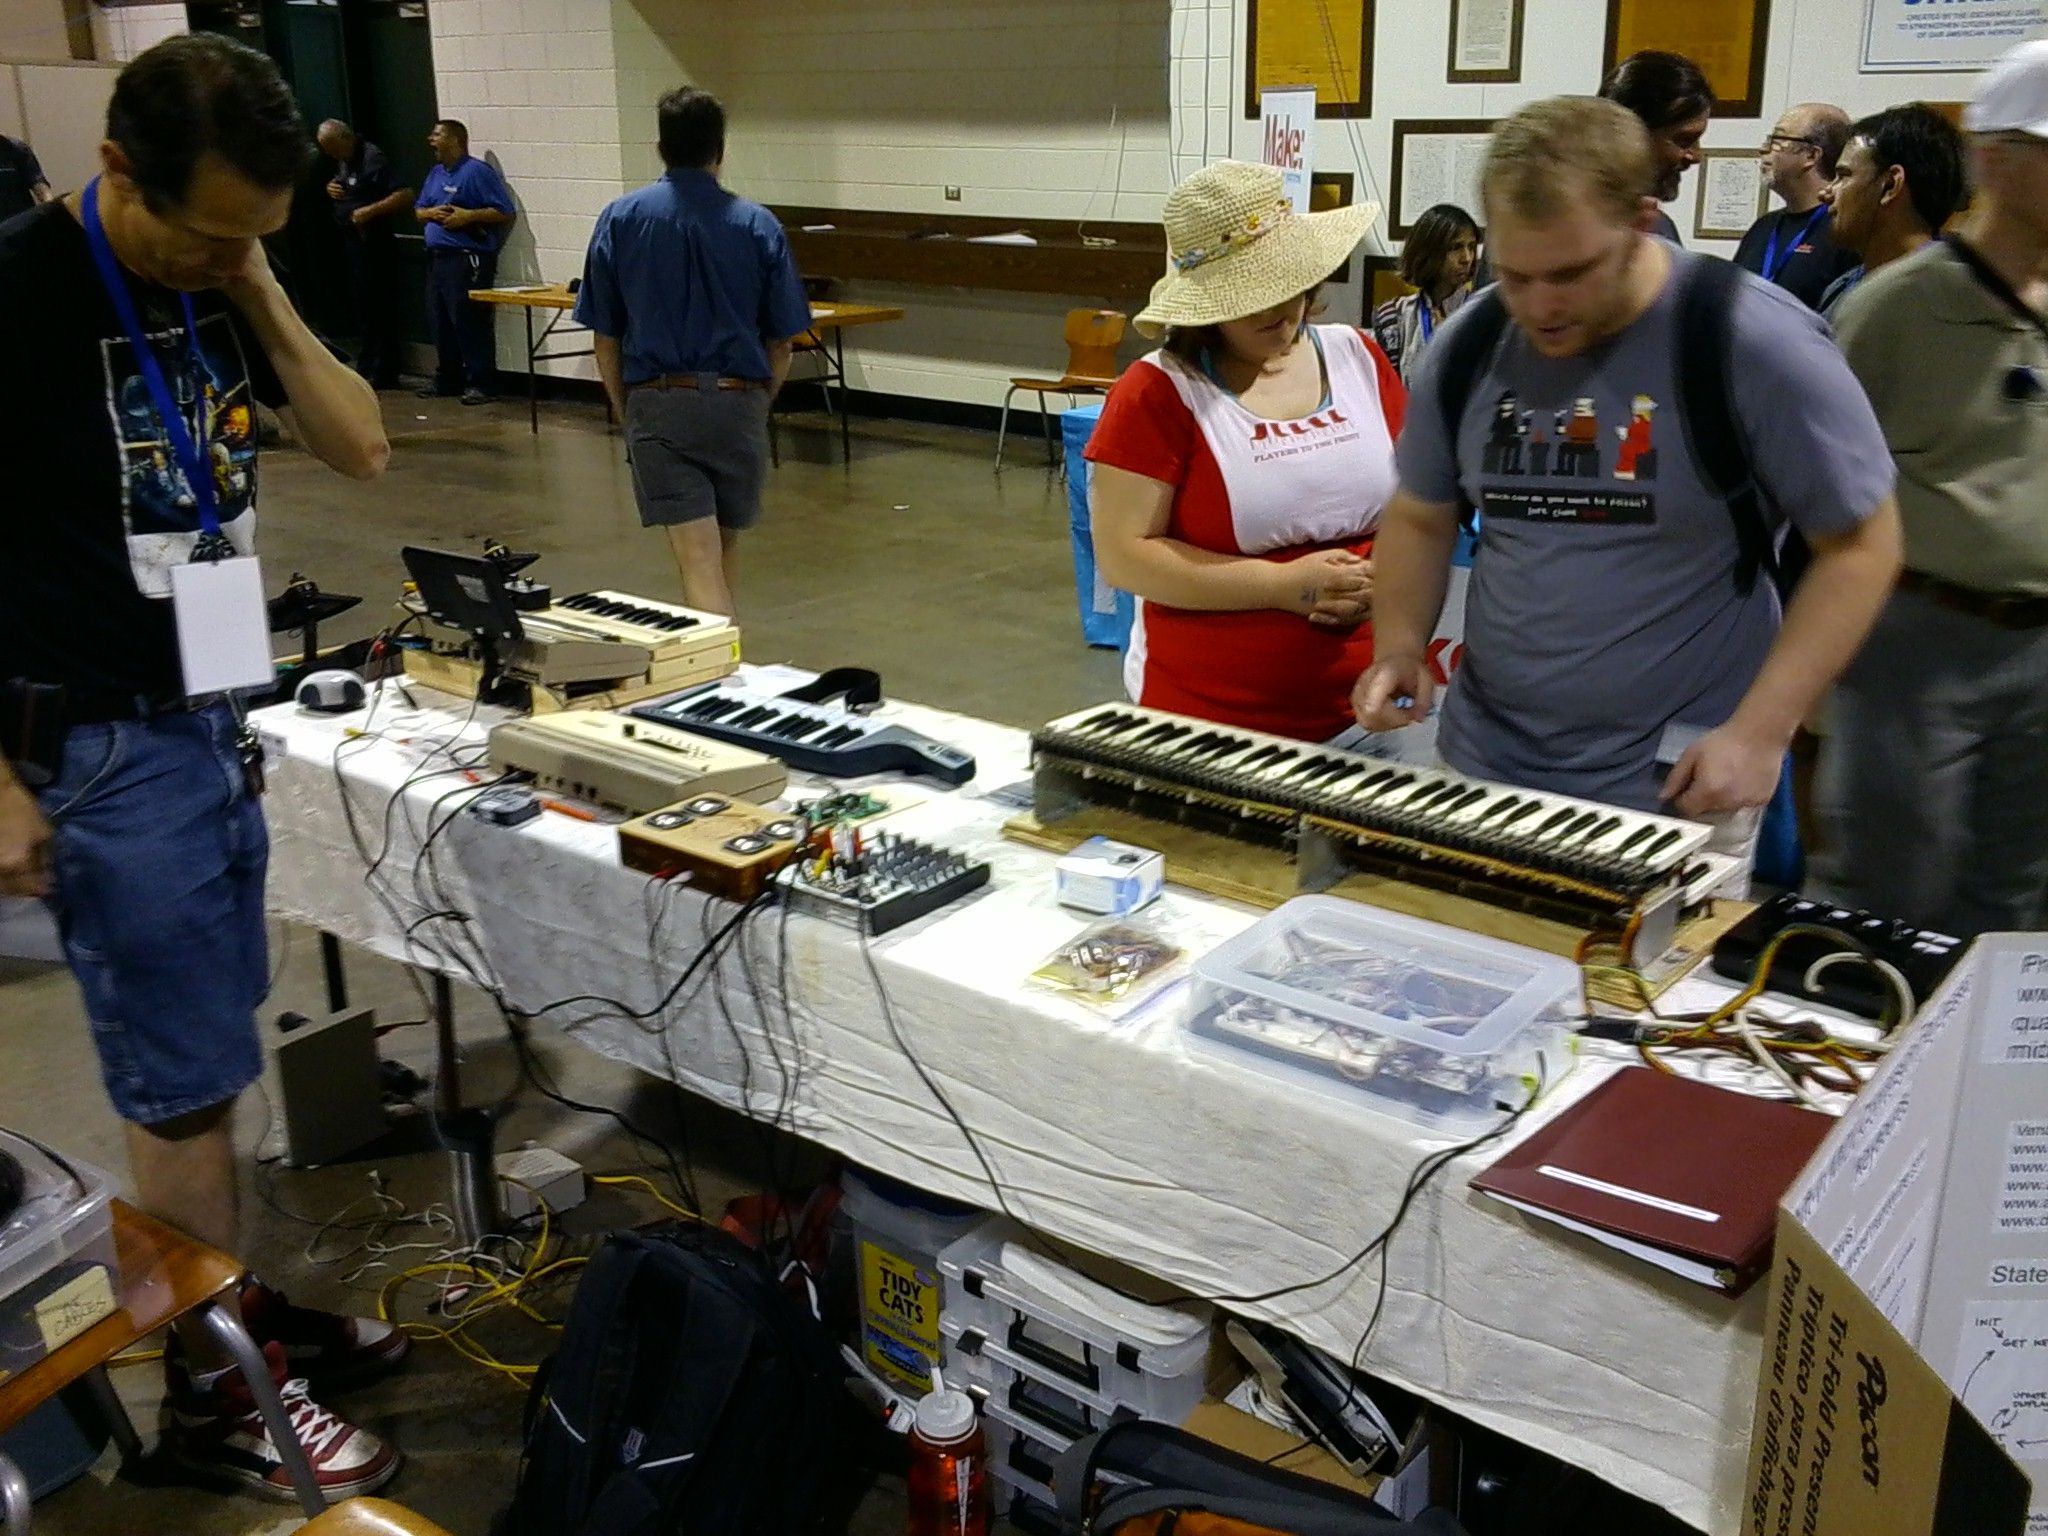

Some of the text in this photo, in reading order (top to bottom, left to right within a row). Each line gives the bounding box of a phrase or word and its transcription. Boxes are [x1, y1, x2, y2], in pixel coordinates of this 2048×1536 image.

[1263, 114, 1306, 170] Make:
[879, 1266, 923, 1301] TIDY
[879, 1287, 924, 1324] CATS
[1773, 1257, 1802, 1384] Panneau
[1975, 1318, 2002, 1327] INIT
[2002, 1338, 2028, 1348] GET
[1818, 1311, 1848, 1430] Tri-Fold
[1786, 1394, 1805, 1470] para
[1856, 1351, 1888, 1489] Pacon
